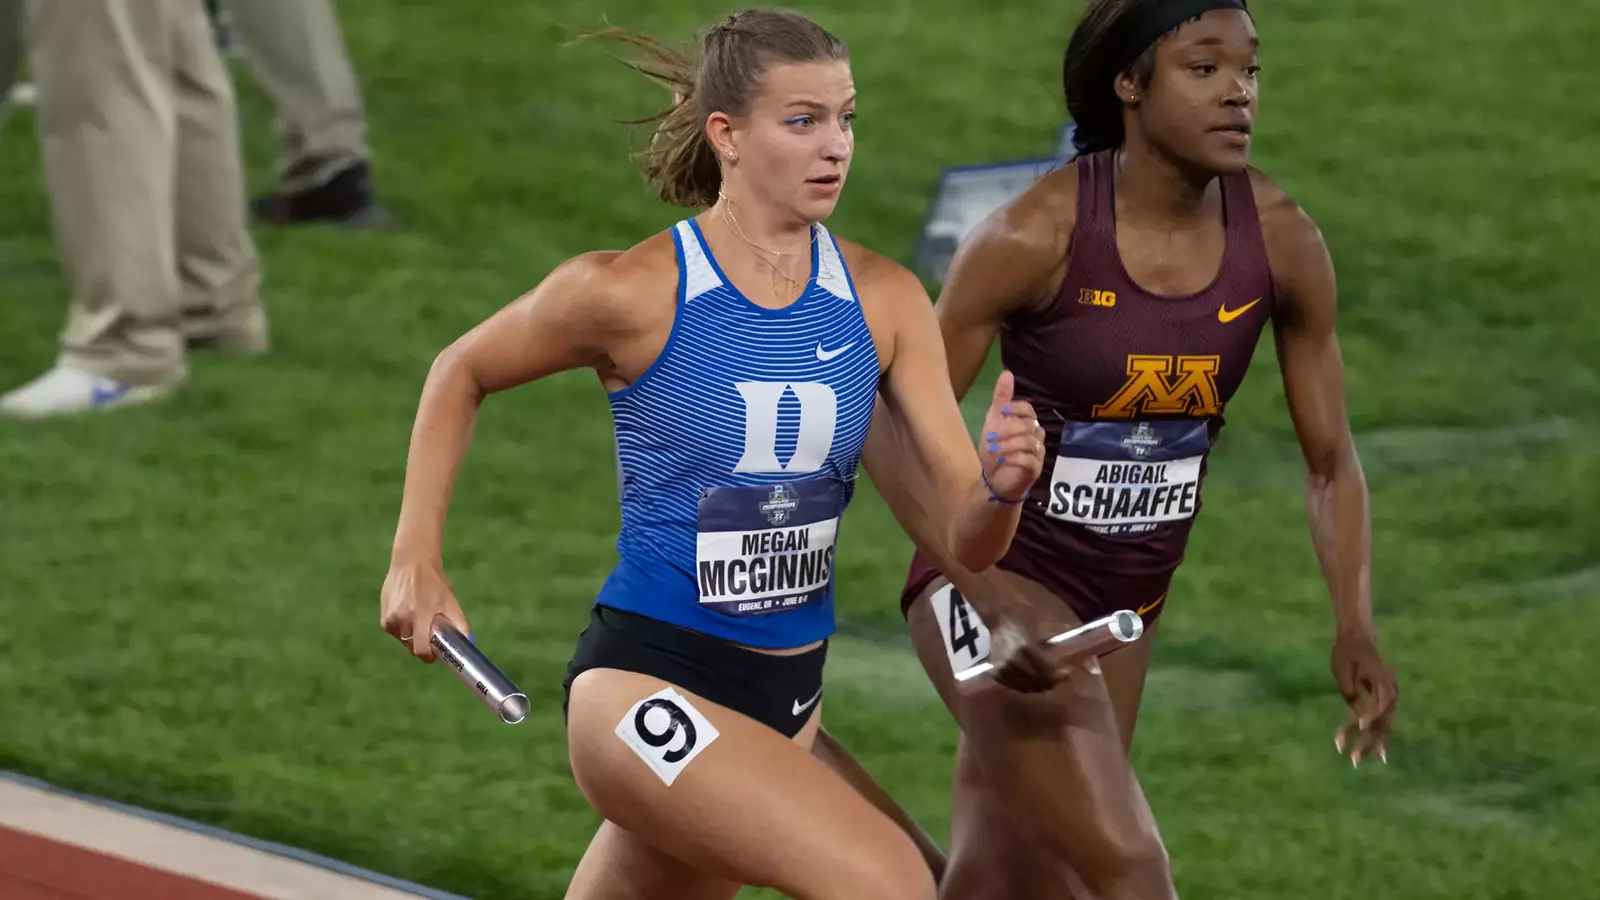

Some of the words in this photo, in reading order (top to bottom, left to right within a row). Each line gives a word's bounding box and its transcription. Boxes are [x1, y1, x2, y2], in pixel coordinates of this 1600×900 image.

[1092, 354, 1221, 418] M
[732, 381, 837, 472] D
[1051, 481, 1196, 519] SCHAAFFE
[1095, 464, 1167, 484] ABIGAIL
[742, 528, 809, 556] MEGAN
[699, 545, 834, 597] MCGINNIS
[950, 587, 979, 659] 4
[476, 681, 489, 696] GILL
[634, 698, 697, 763] 9
